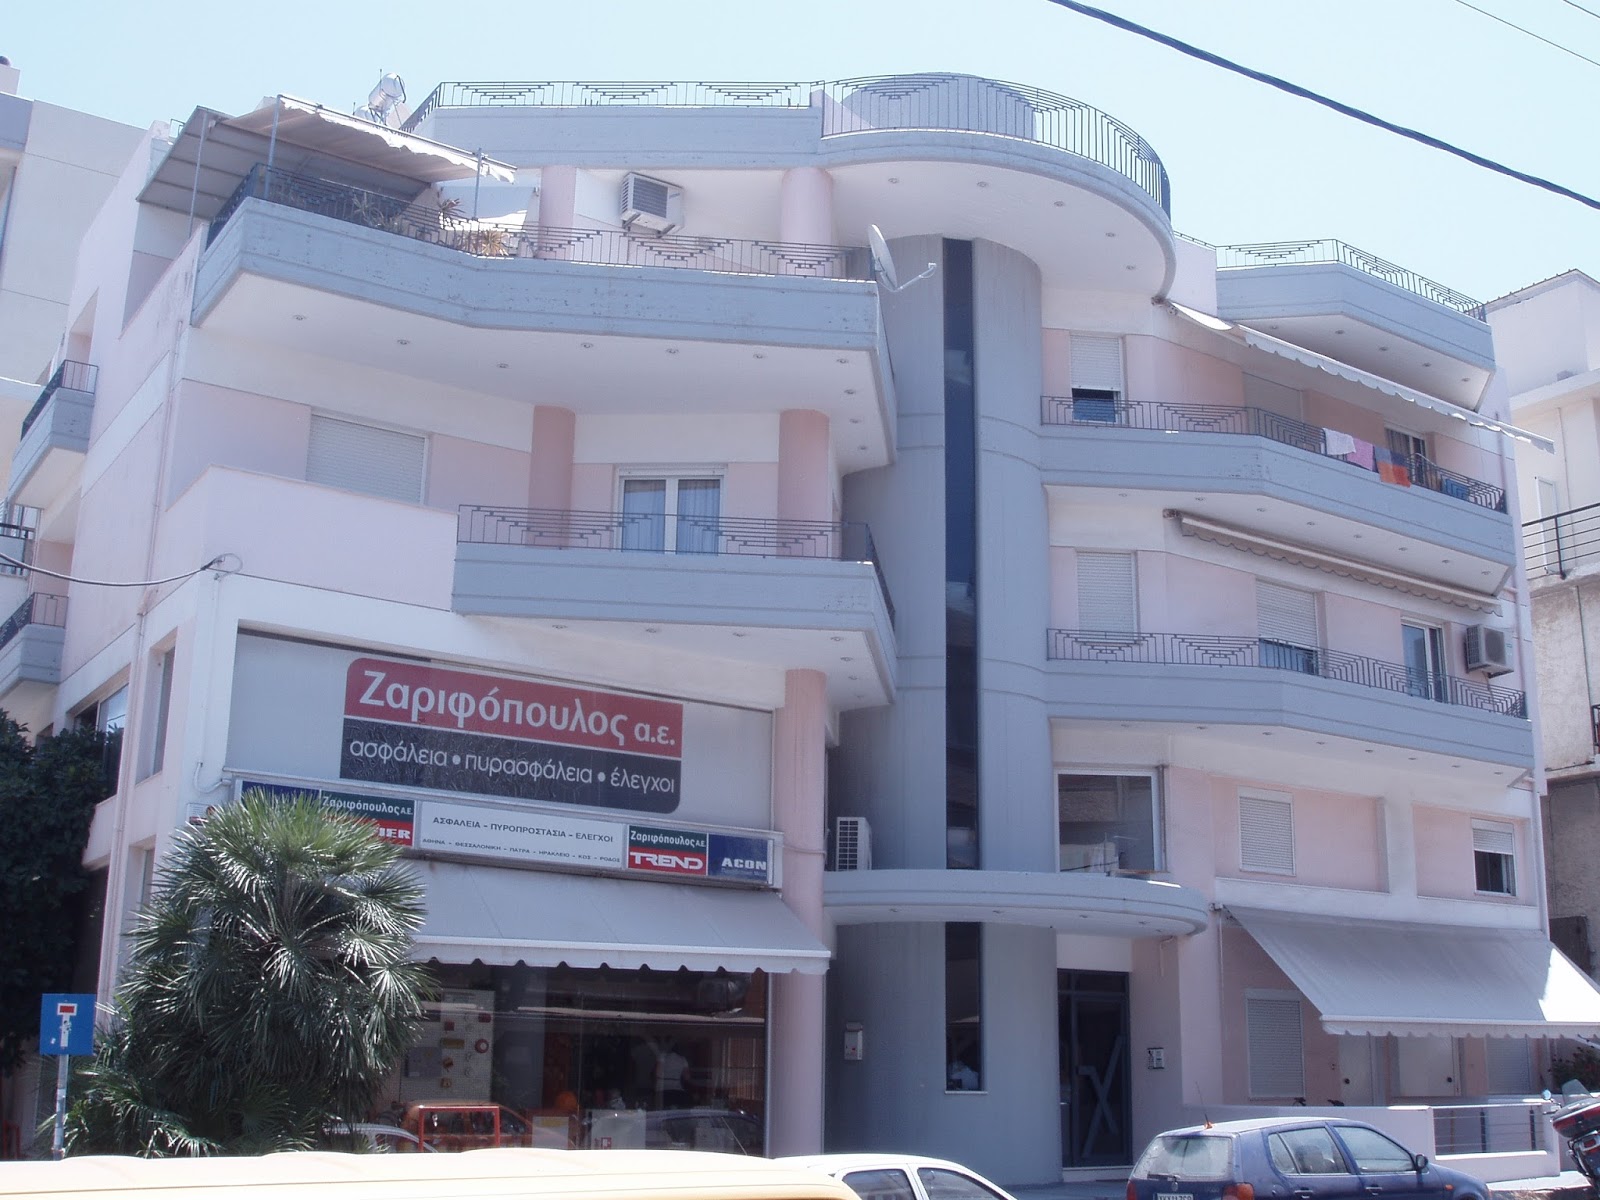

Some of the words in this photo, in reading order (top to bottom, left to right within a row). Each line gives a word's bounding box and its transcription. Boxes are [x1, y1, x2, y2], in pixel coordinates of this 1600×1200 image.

[359, 670, 628, 746] Ζαριφόπουλος
[634, 721, 676, 746] α.ε.
[349, 738, 448, 767] ασφάλεια
[465, 754, 593, 784] πυρασφάλεια
[610, 766, 675, 794] έλεγχοι
[322, 796, 400, 816] Ζαριφόπουλος
[433, 816, 481, 828] ΑΣΦΑΛΕΙΑ
[490, 823, 566, 838] ΠΥΡΟΠΡΟΣΤΑΣΙΑ
[575, 832, 614, 843] ΕΛΕΓΧΟΙ
[630, 830, 695, 848] Ζαριφόπουλος
[630, 851, 704, 869] TREND
[721, 857, 767, 871] ACON
